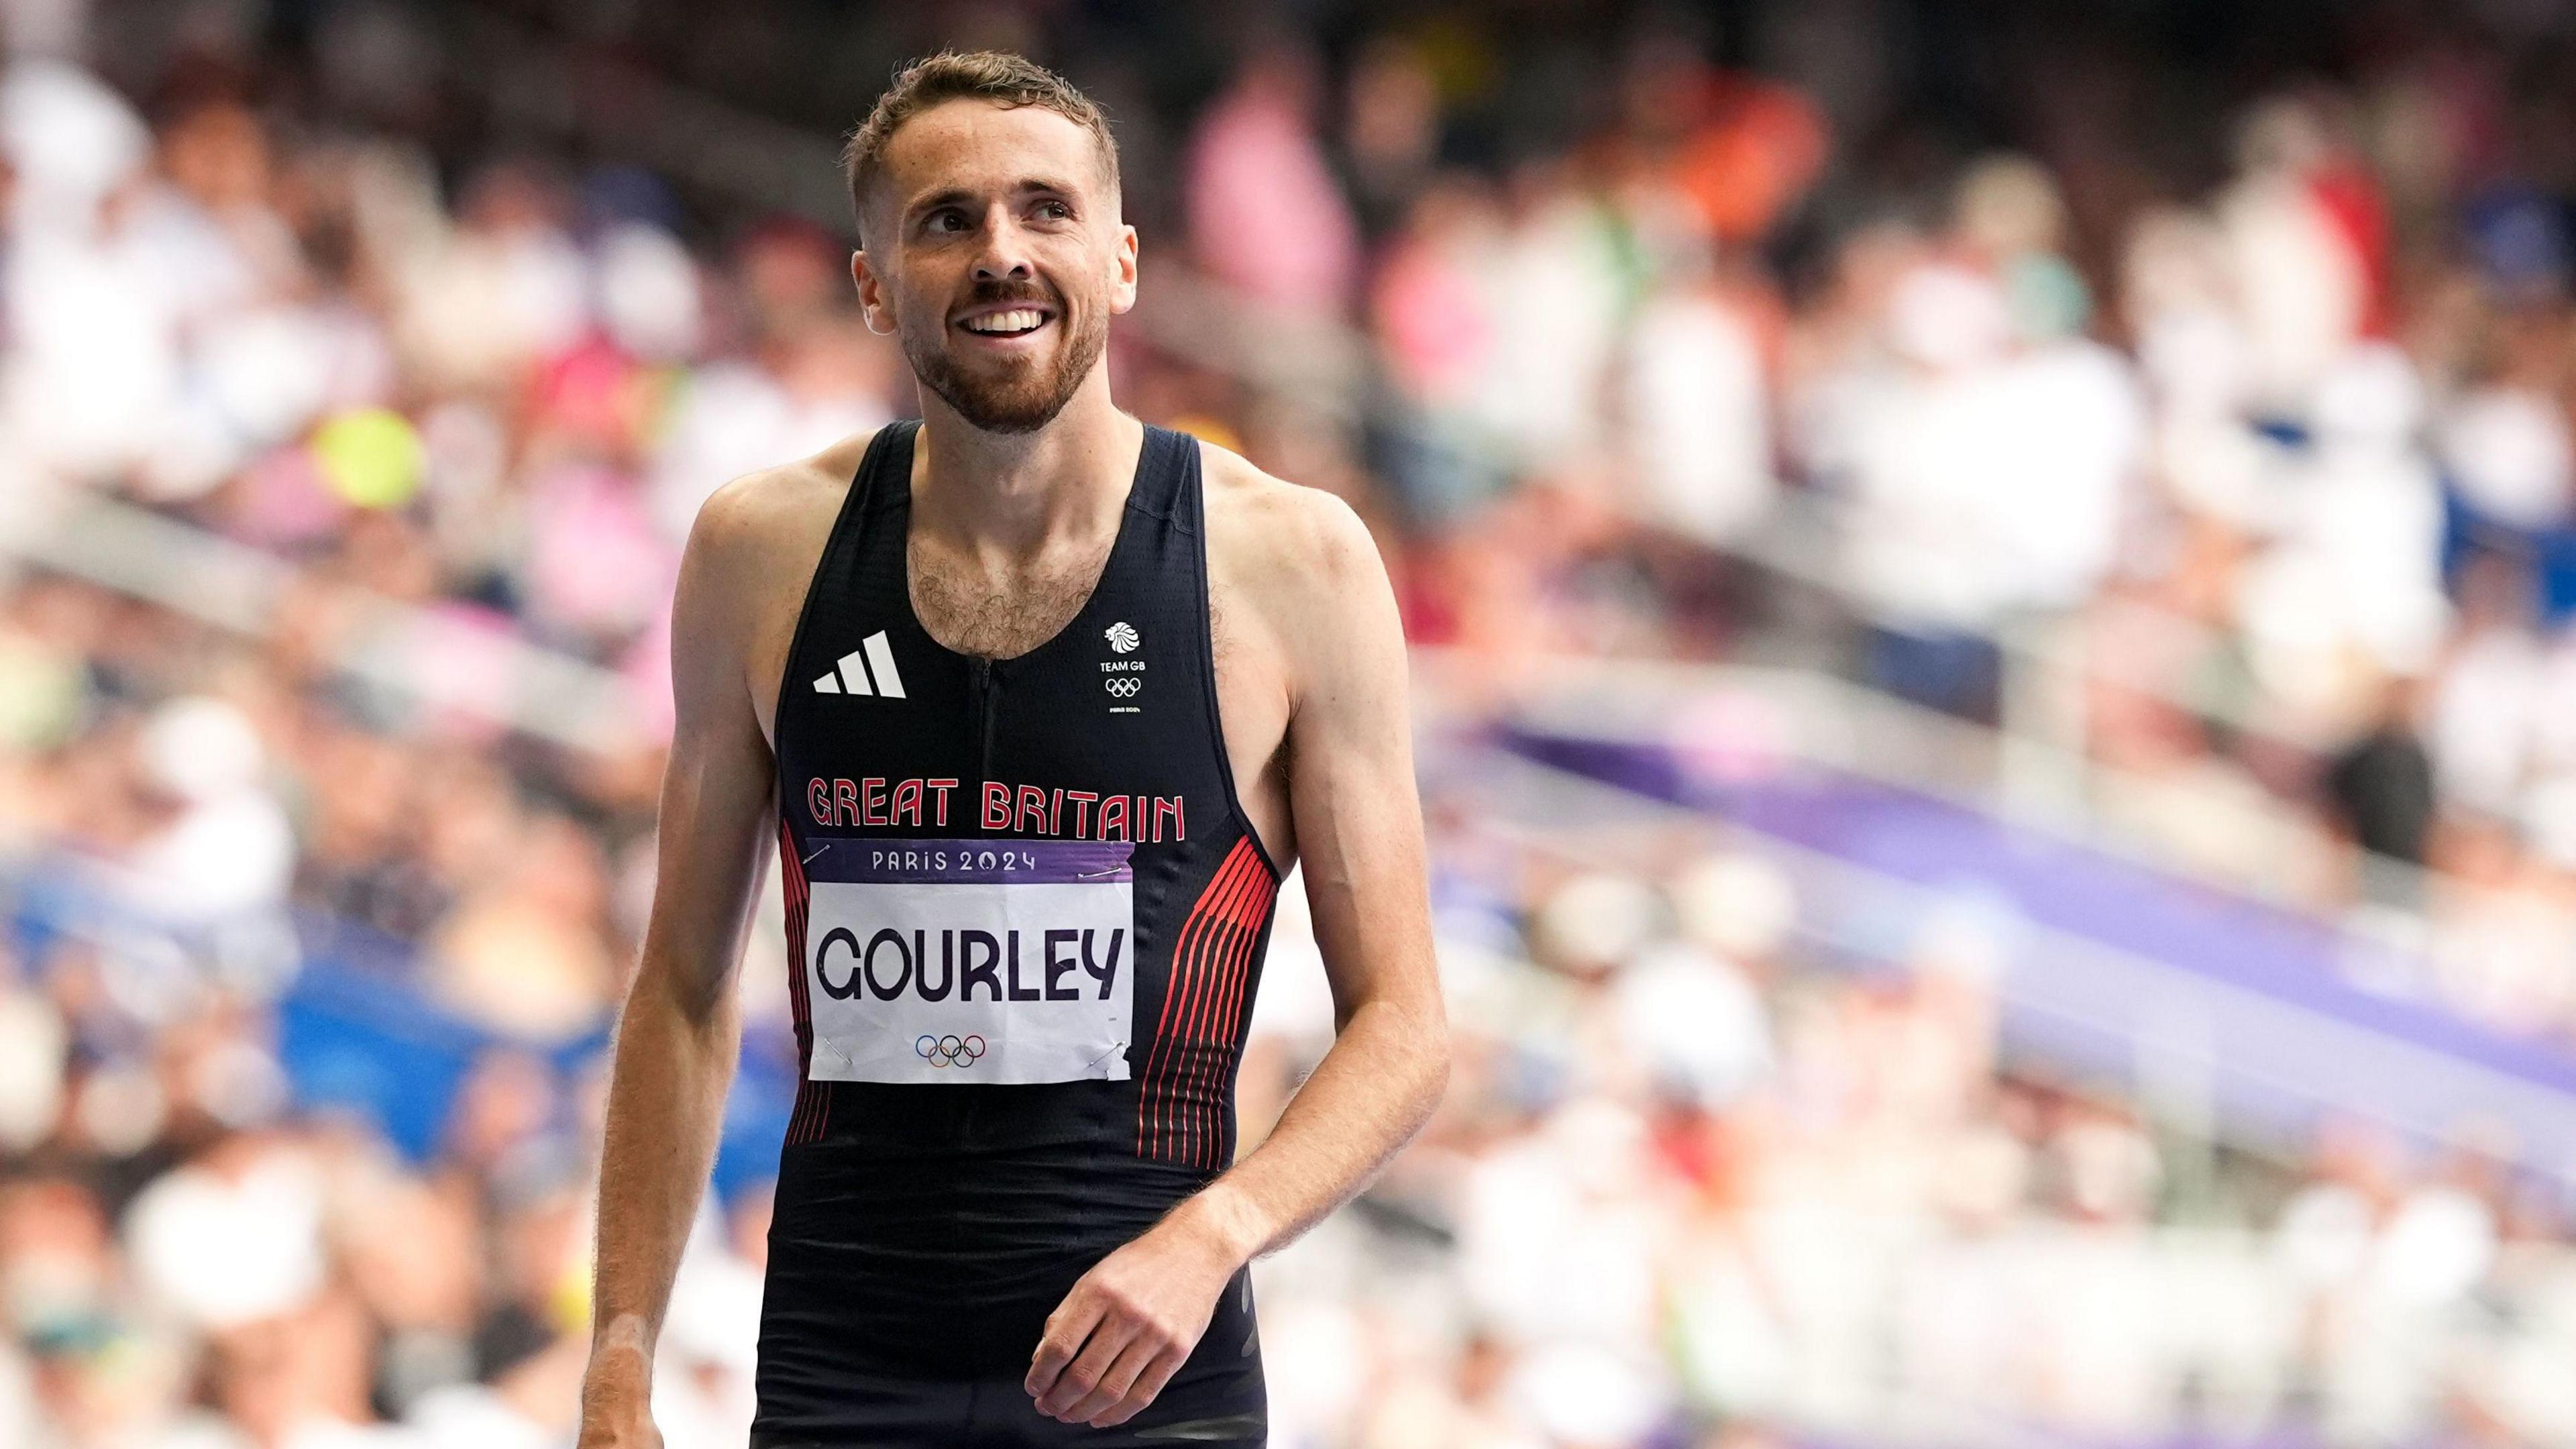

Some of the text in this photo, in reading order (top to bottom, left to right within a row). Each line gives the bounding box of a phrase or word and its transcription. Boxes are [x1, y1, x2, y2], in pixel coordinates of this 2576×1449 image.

[1100, 661, 1146, 672] TEAM GB
[808, 777, 1185, 843] GREAT BRITAIN
[960, 851, 1035, 871] 2024
[816, 927, 1124, 1002] GOURLEY
